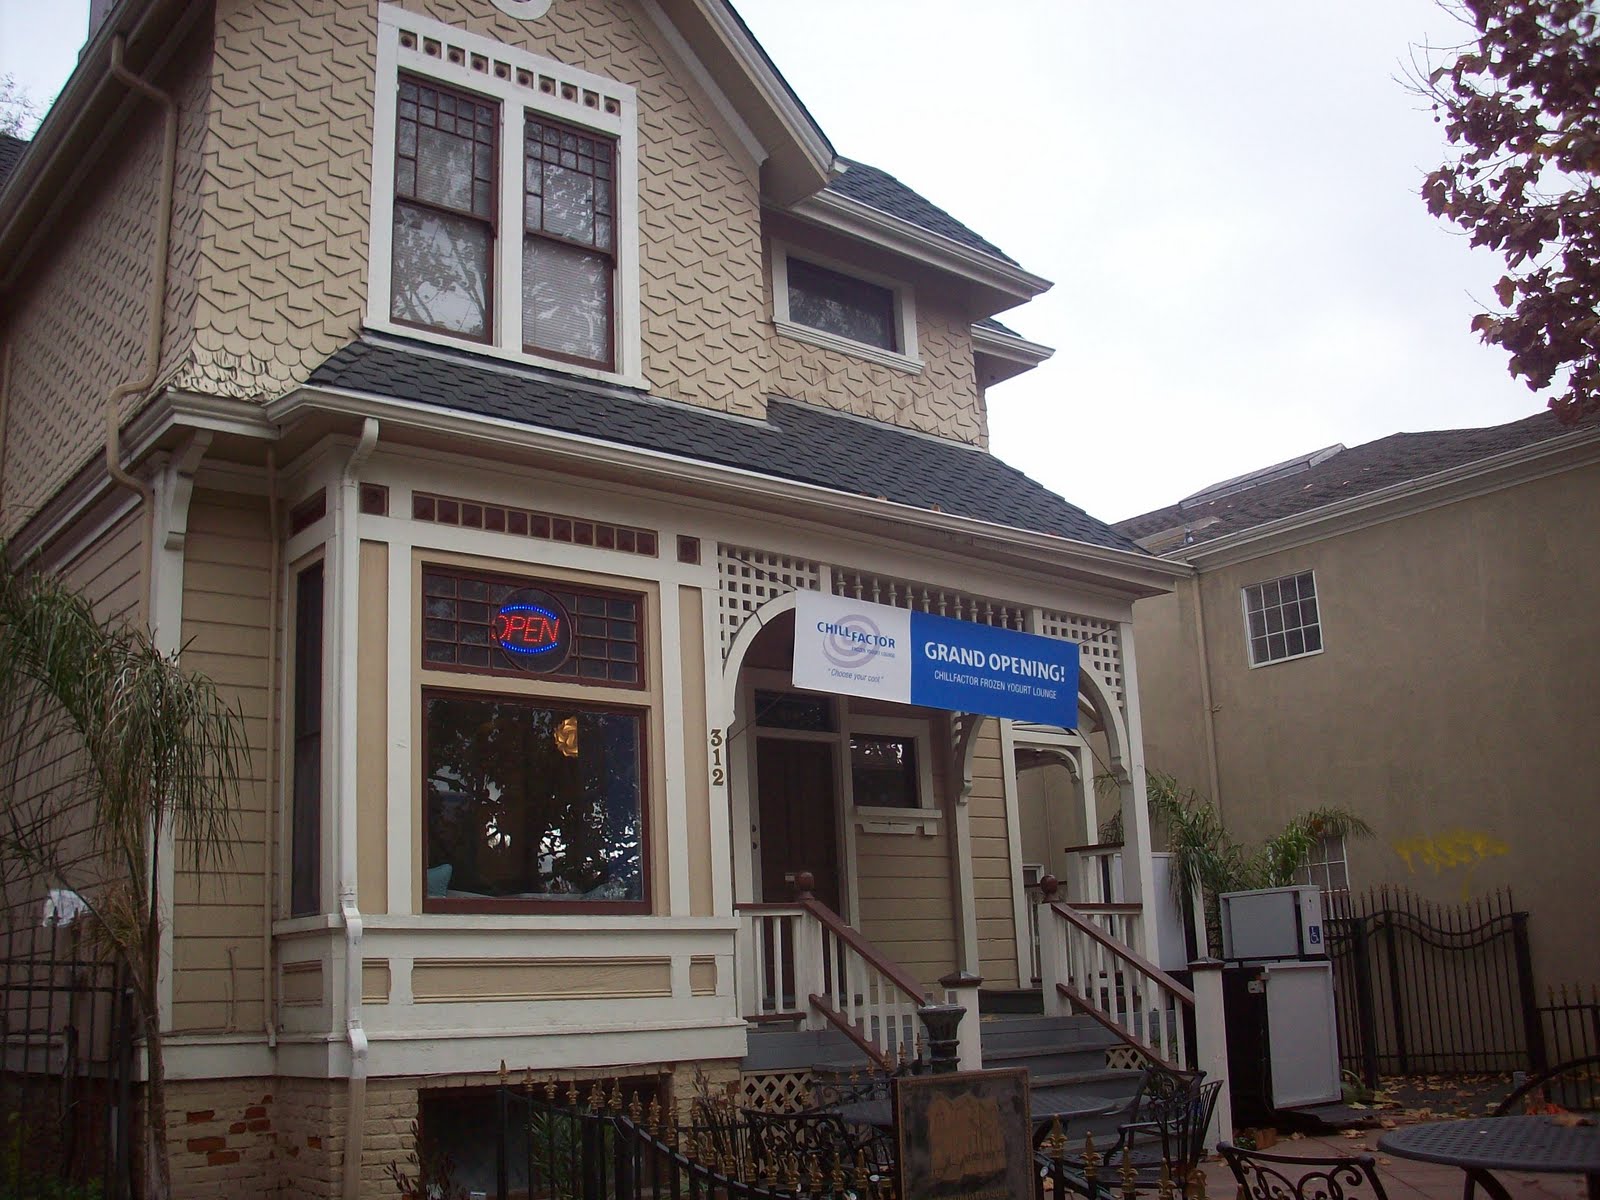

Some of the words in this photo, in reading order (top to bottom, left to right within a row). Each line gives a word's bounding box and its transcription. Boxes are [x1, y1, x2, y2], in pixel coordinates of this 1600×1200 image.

[489, 614, 560, 642] OPEN
[817, 621, 896, 649] CHILLFACTOR
[924, 641, 985, 668] GRAND
[988, 653, 1065, 683] OPENING!
[934, 670, 979, 687] CHILLFACTOR
[980, 678, 1006, 691] FROZEN
[1006, 682, 1032, 695] YOGURT
[1032, 687, 1057, 700] LOUNGE
[710, 729, 724, 786] 312
